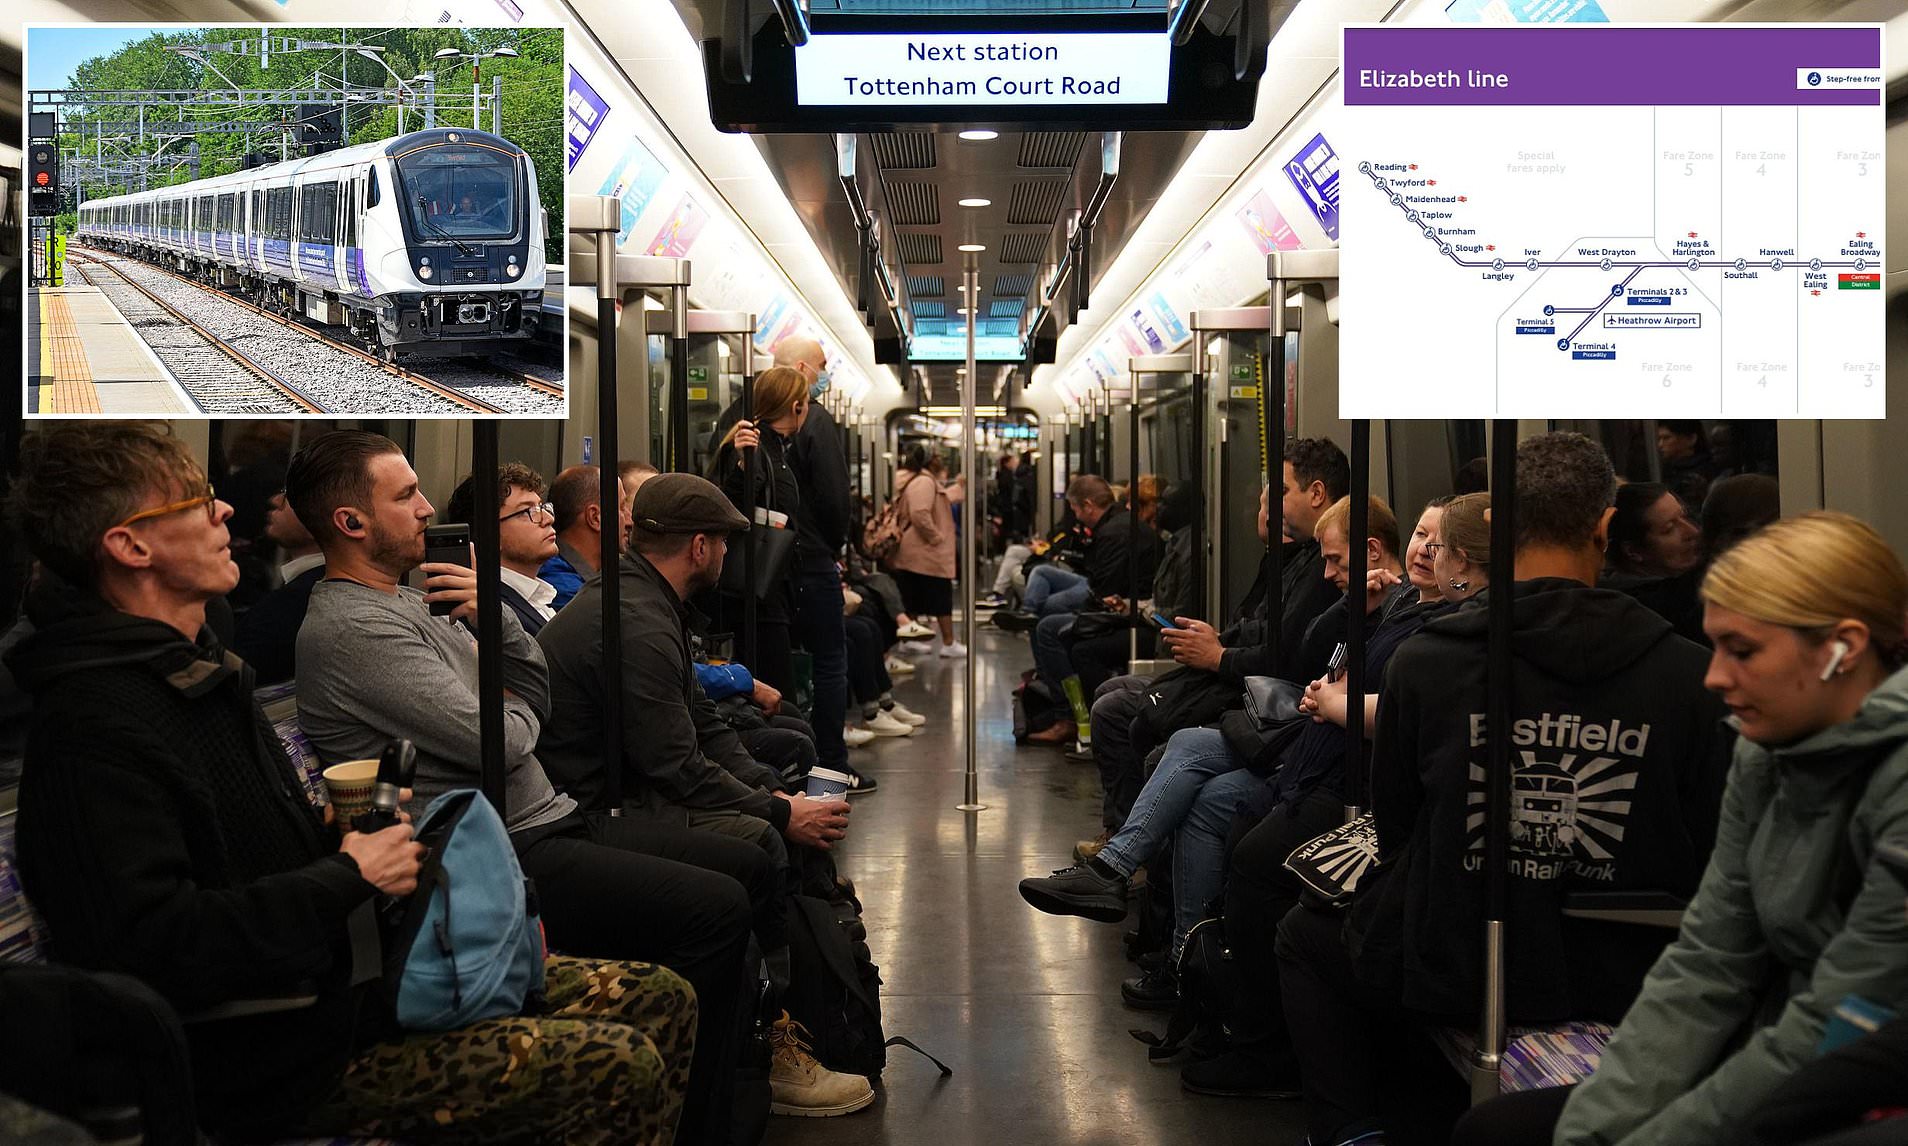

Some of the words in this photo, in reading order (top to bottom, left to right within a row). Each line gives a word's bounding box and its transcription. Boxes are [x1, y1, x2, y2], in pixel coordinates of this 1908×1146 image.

[908, 43, 965, 61] Next
[974, 42, 1058, 61] station
[844, 77, 976, 96] Tottenham
[985, 77, 1054, 96] Court
[1061, 77, 1121, 96] Road
[1469, 713, 1650, 757] Estfield
[1297, 833, 1338, 860] Punk
[1463, 855, 1521, 876] Urn
